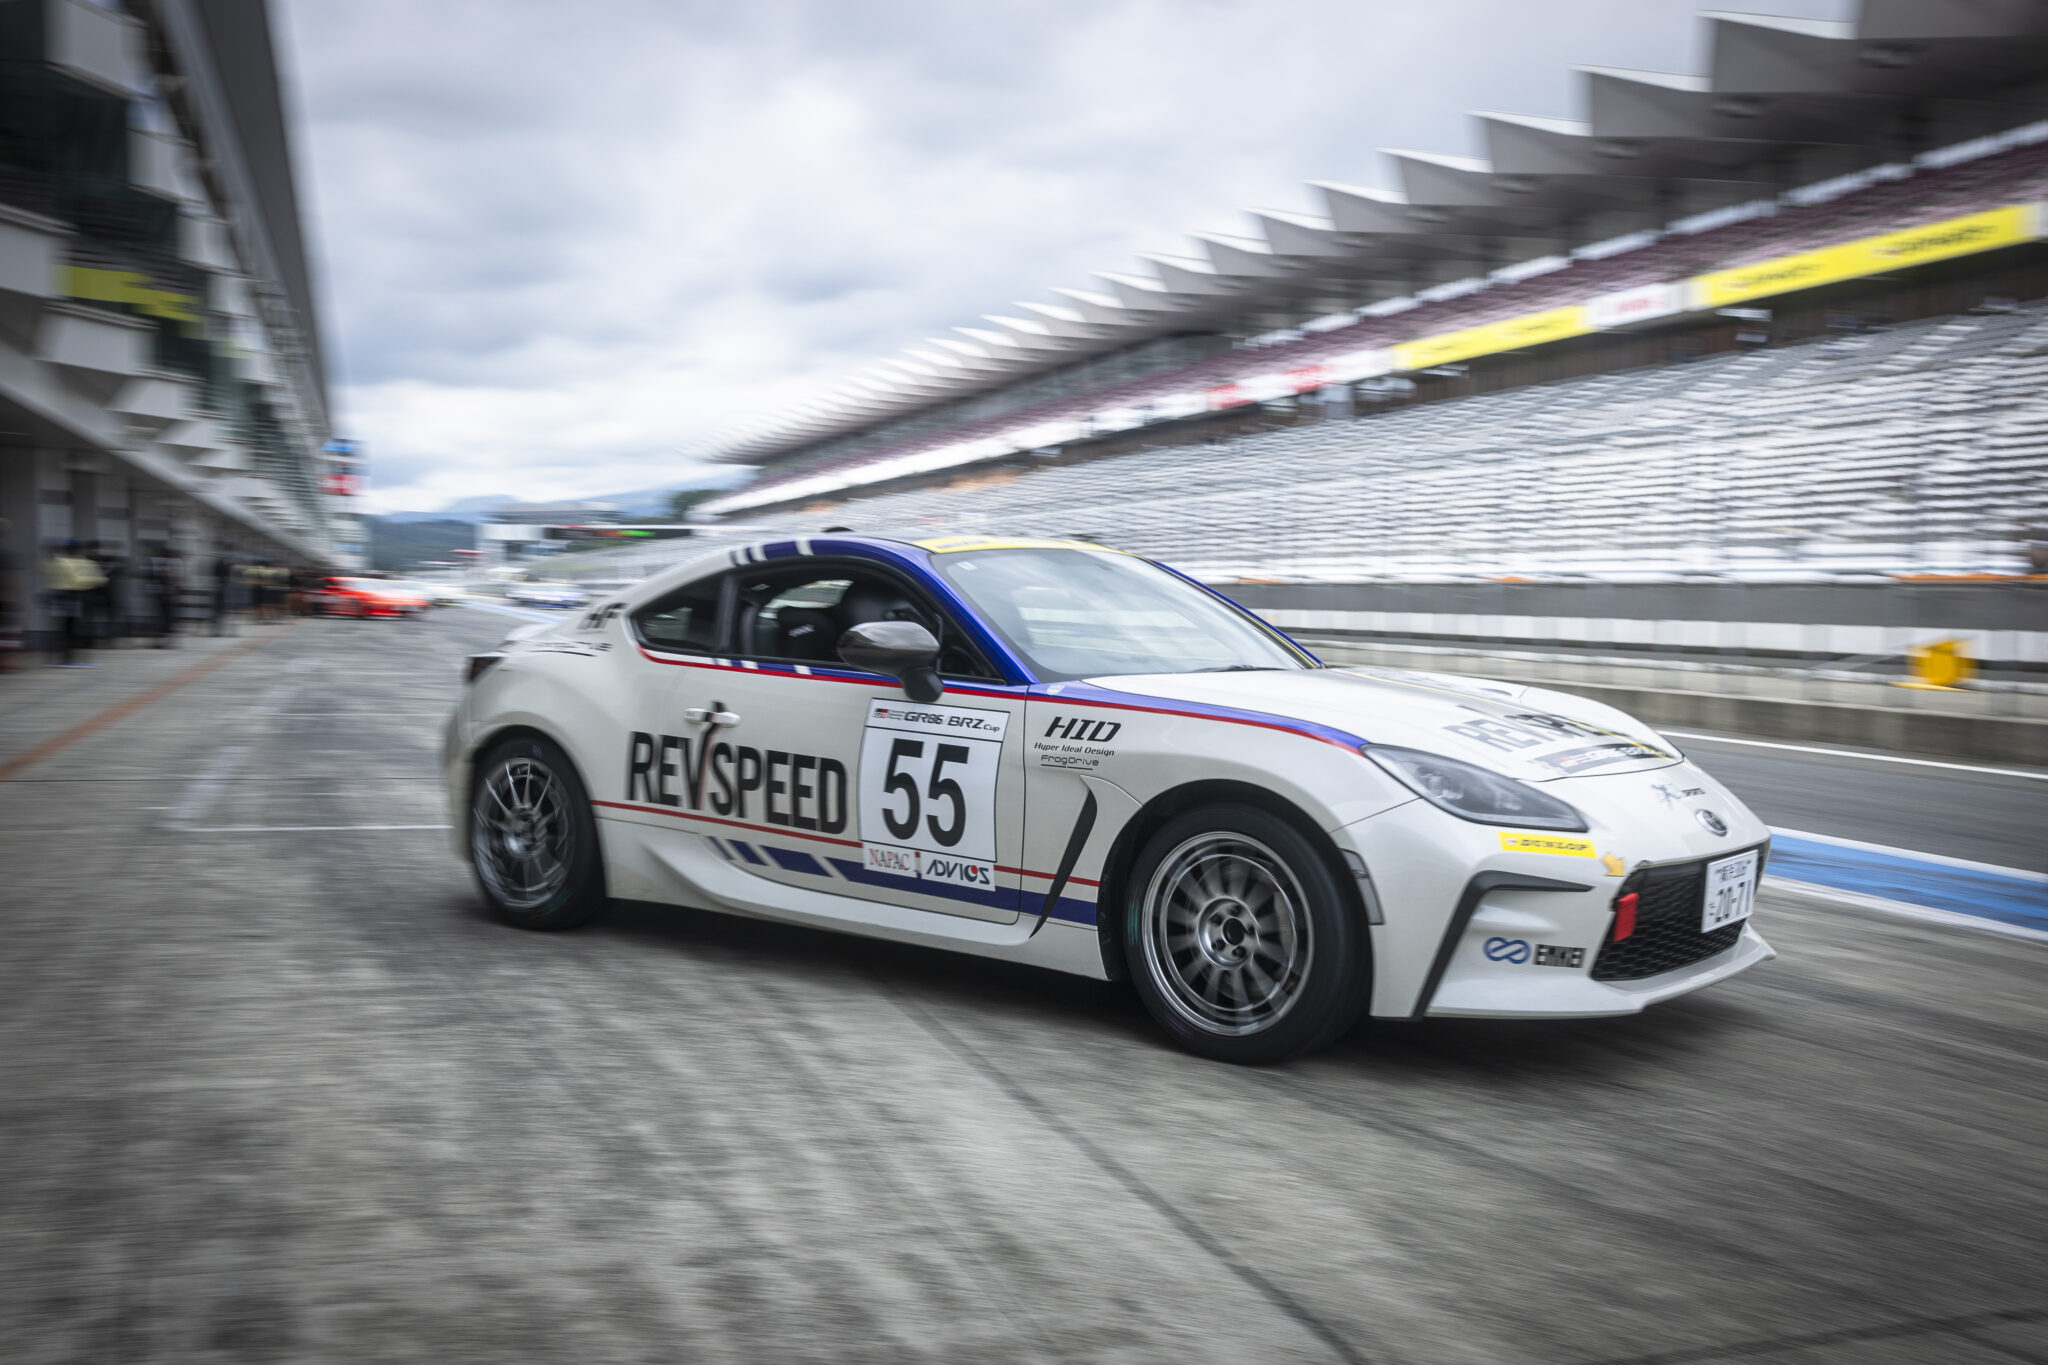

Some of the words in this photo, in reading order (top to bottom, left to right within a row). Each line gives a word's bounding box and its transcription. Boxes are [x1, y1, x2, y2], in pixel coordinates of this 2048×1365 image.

[1044, 716, 1122, 742] HID
[1034, 742, 1060, 751] Hyper
[1061, 745, 1083, 753] Ideal
[1084, 746, 1115, 756] Design
[1040, 754, 1100, 766] FrogDrive
[626, 701, 848, 834] REVSPEED
[881, 738, 970, 847] 55
[868, 848, 910, 871] NAPAC
[926, 859, 990, 885] ADVICS
